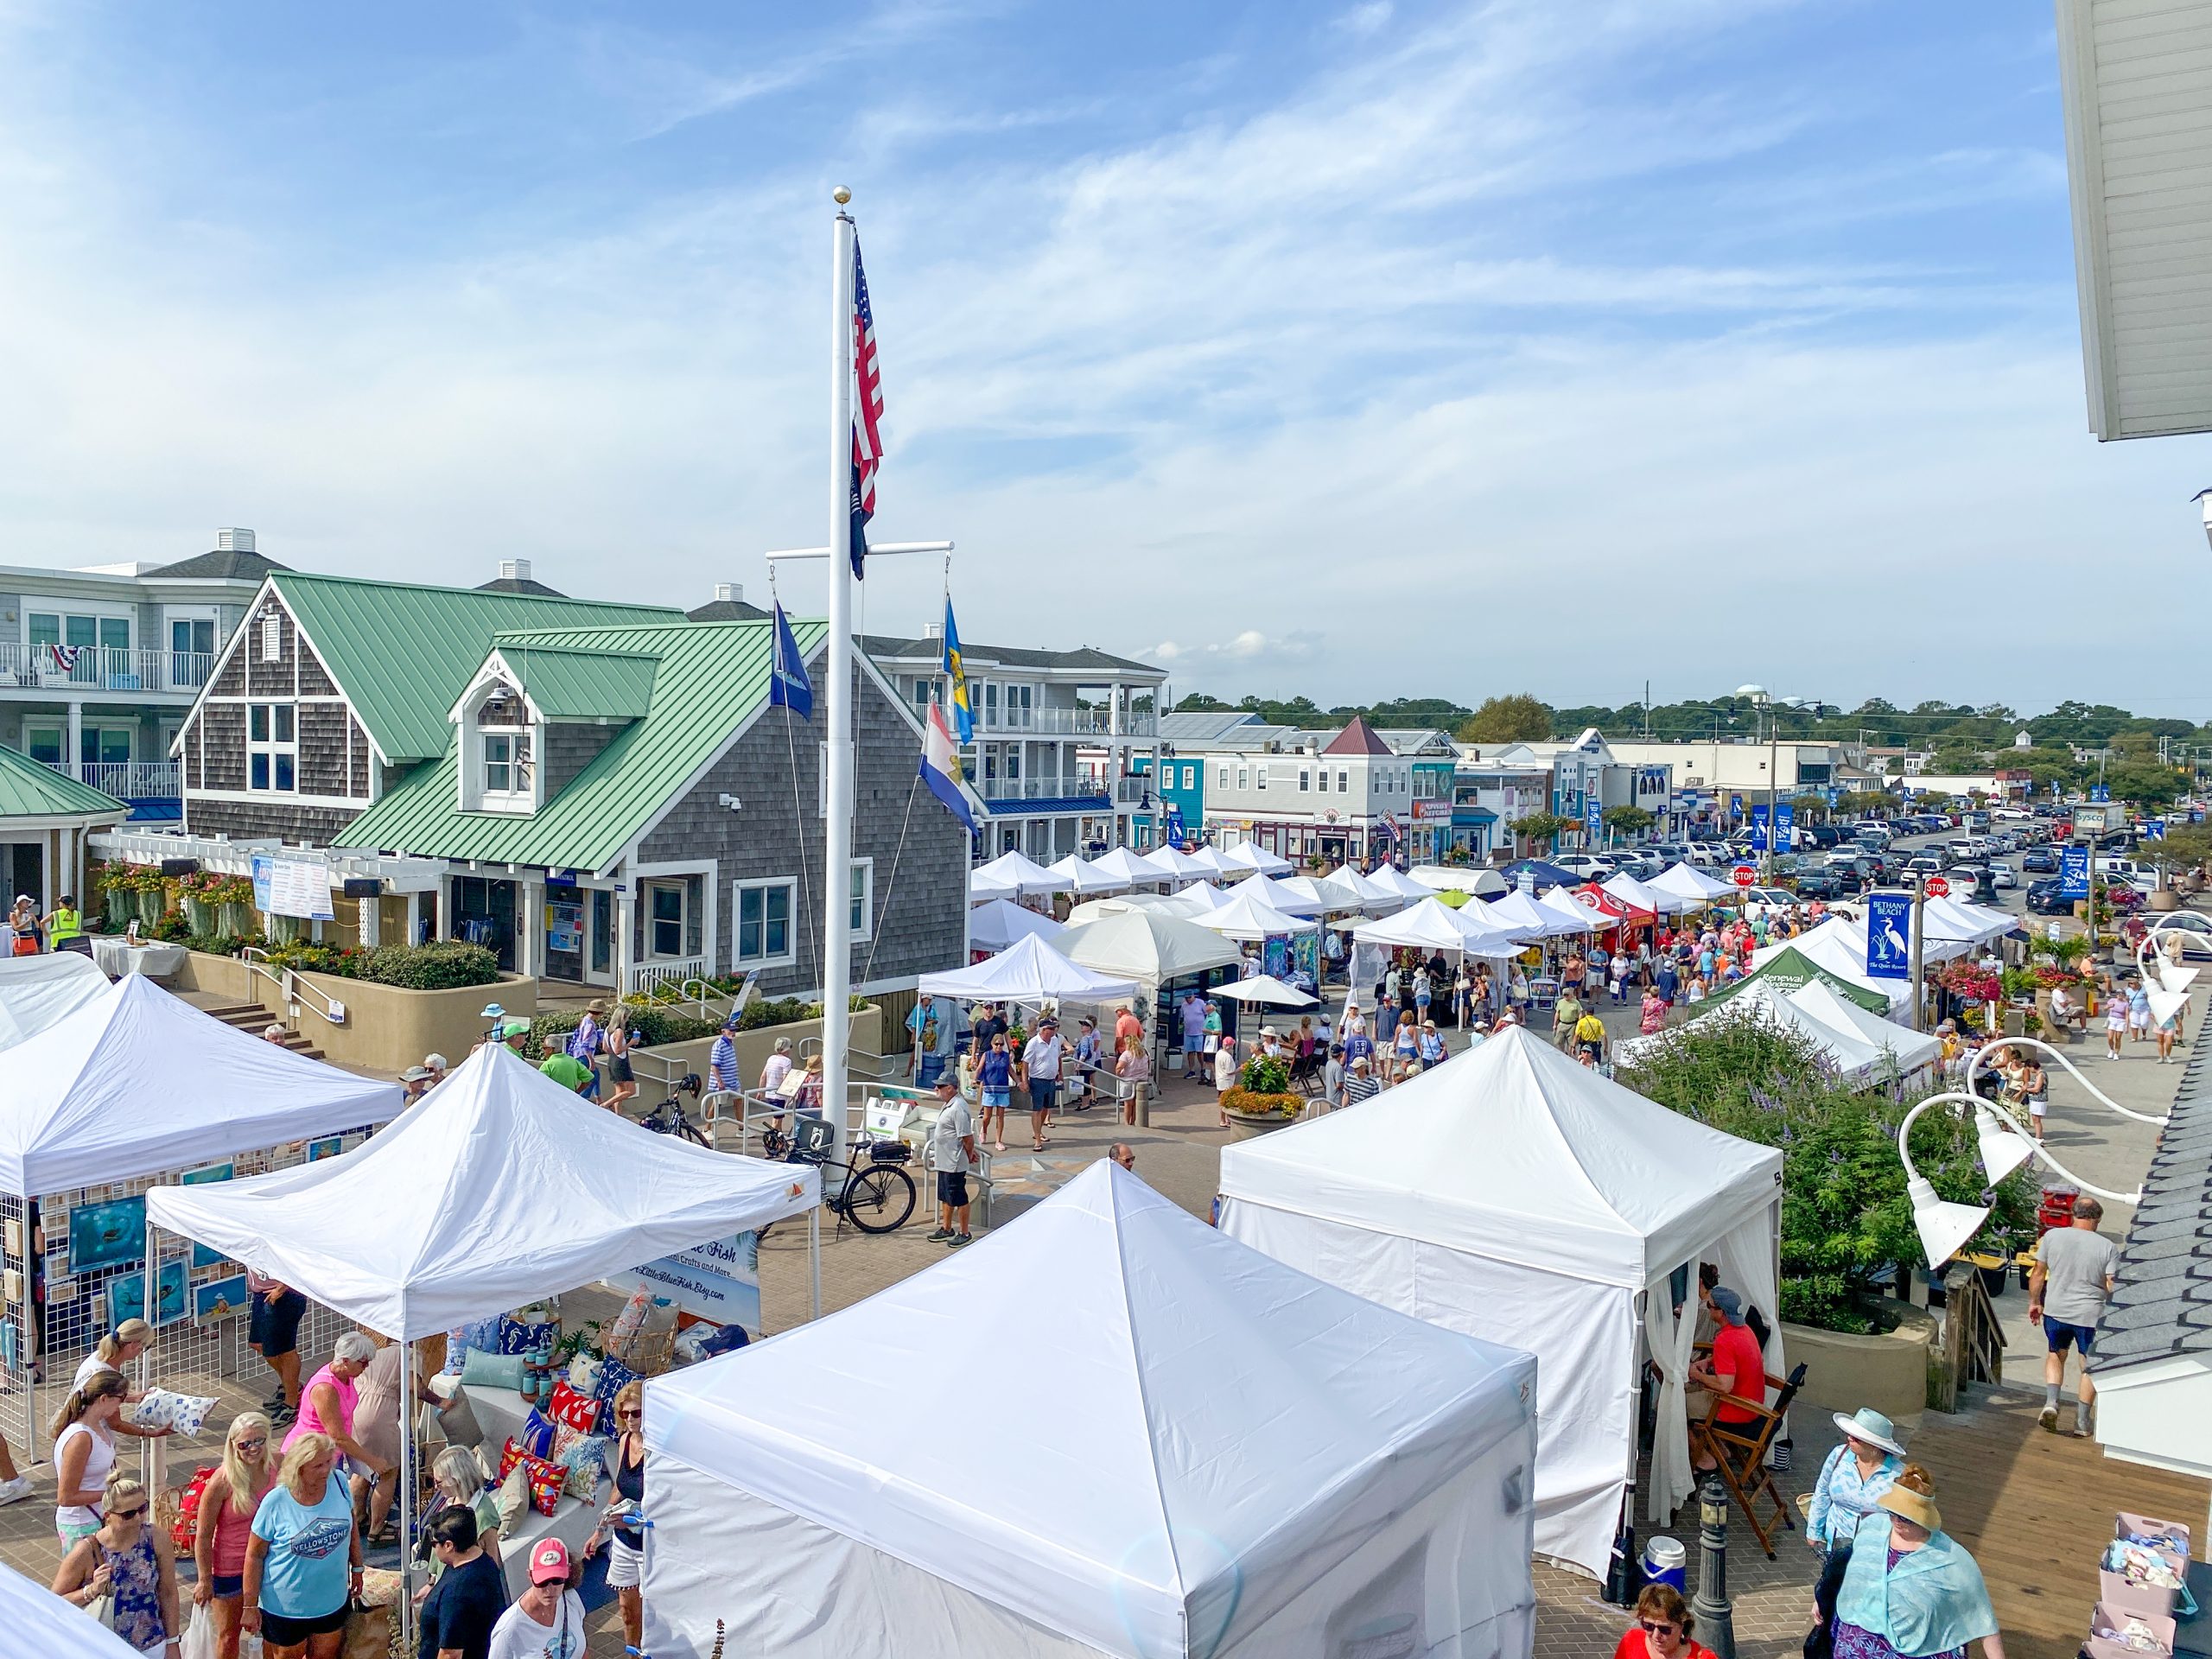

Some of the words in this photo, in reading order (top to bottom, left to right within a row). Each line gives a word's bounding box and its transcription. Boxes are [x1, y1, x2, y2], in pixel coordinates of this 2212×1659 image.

[2076, 812, 2103, 822] Sysco
[1388, 822, 1399, 837] OPEN
[1734, 872, 1754, 880] STOP
[1926, 883, 1948, 893] STOP
[1872, 901, 1906, 910] BETHANY
[1764, 973, 1804, 983] Renewal
[1770, 980, 1802, 988] Andersen
[707, 1241, 736, 1263] Fish
[680, 1255, 701, 1268] Crafts
[701, 1262, 715, 1274] and
[714, 1267, 736, 1279] More...
[294, 1529, 347, 1552] YELLOWSTONE
